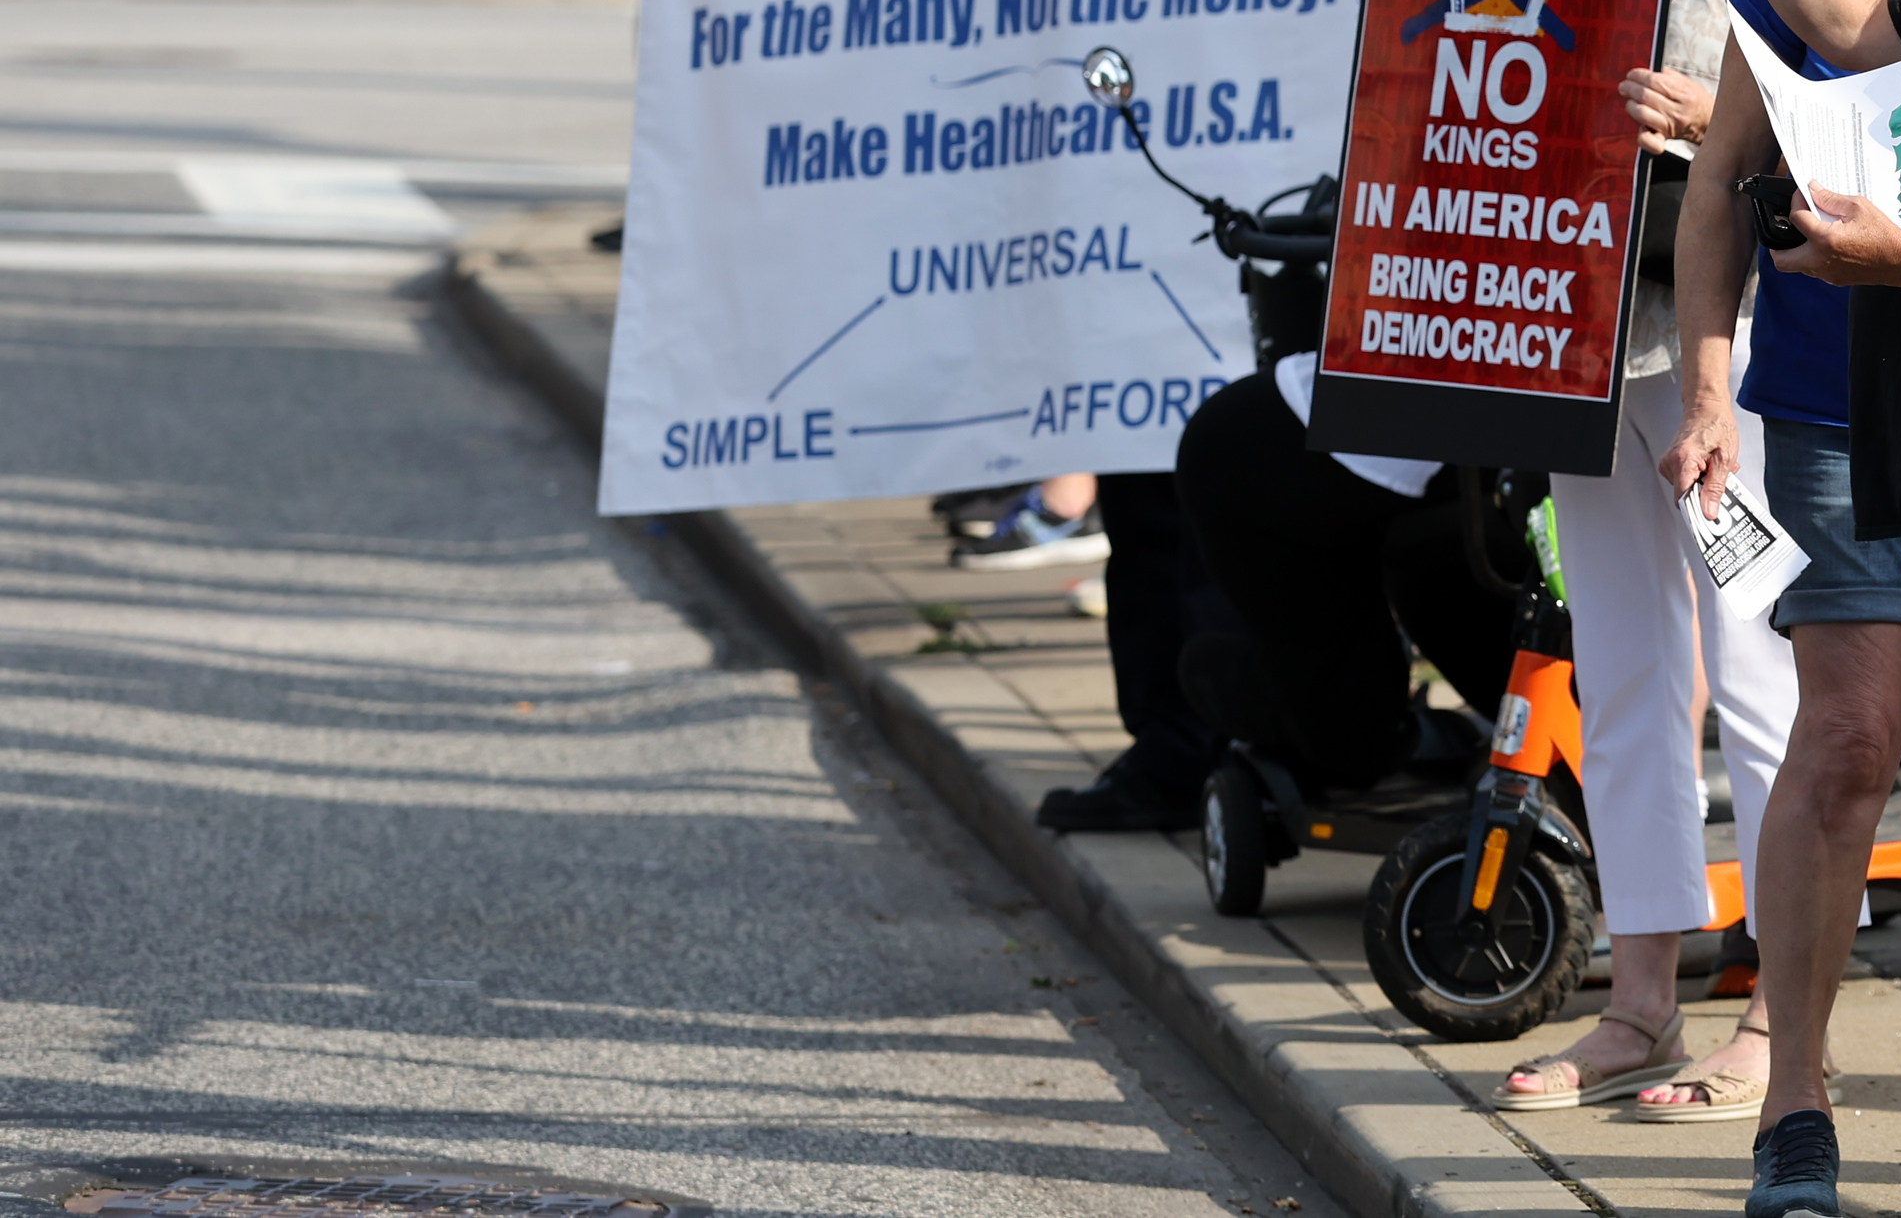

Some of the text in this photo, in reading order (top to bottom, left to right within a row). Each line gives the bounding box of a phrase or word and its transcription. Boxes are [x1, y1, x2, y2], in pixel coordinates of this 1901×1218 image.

[690, 5, 750, 70] For
[1428, 37, 1549, 125] NO
[764, 78, 1294, 190] Make Healthcare U.S.A.
[1422, 123, 1540, 170] KINGS
[1353, 181, 1614, 249] IN AMERICA
[889, 223, 1143, 297] UNIVERSAL
[1368, 252, 1577, 315] BRING BACK
[1360, 309, 1573, 372] DEMOCRACY
[662, 409, 836, 470] SIMPLE
[1716, 535, 1770, 586] REFUSEFASCISM.ORG
